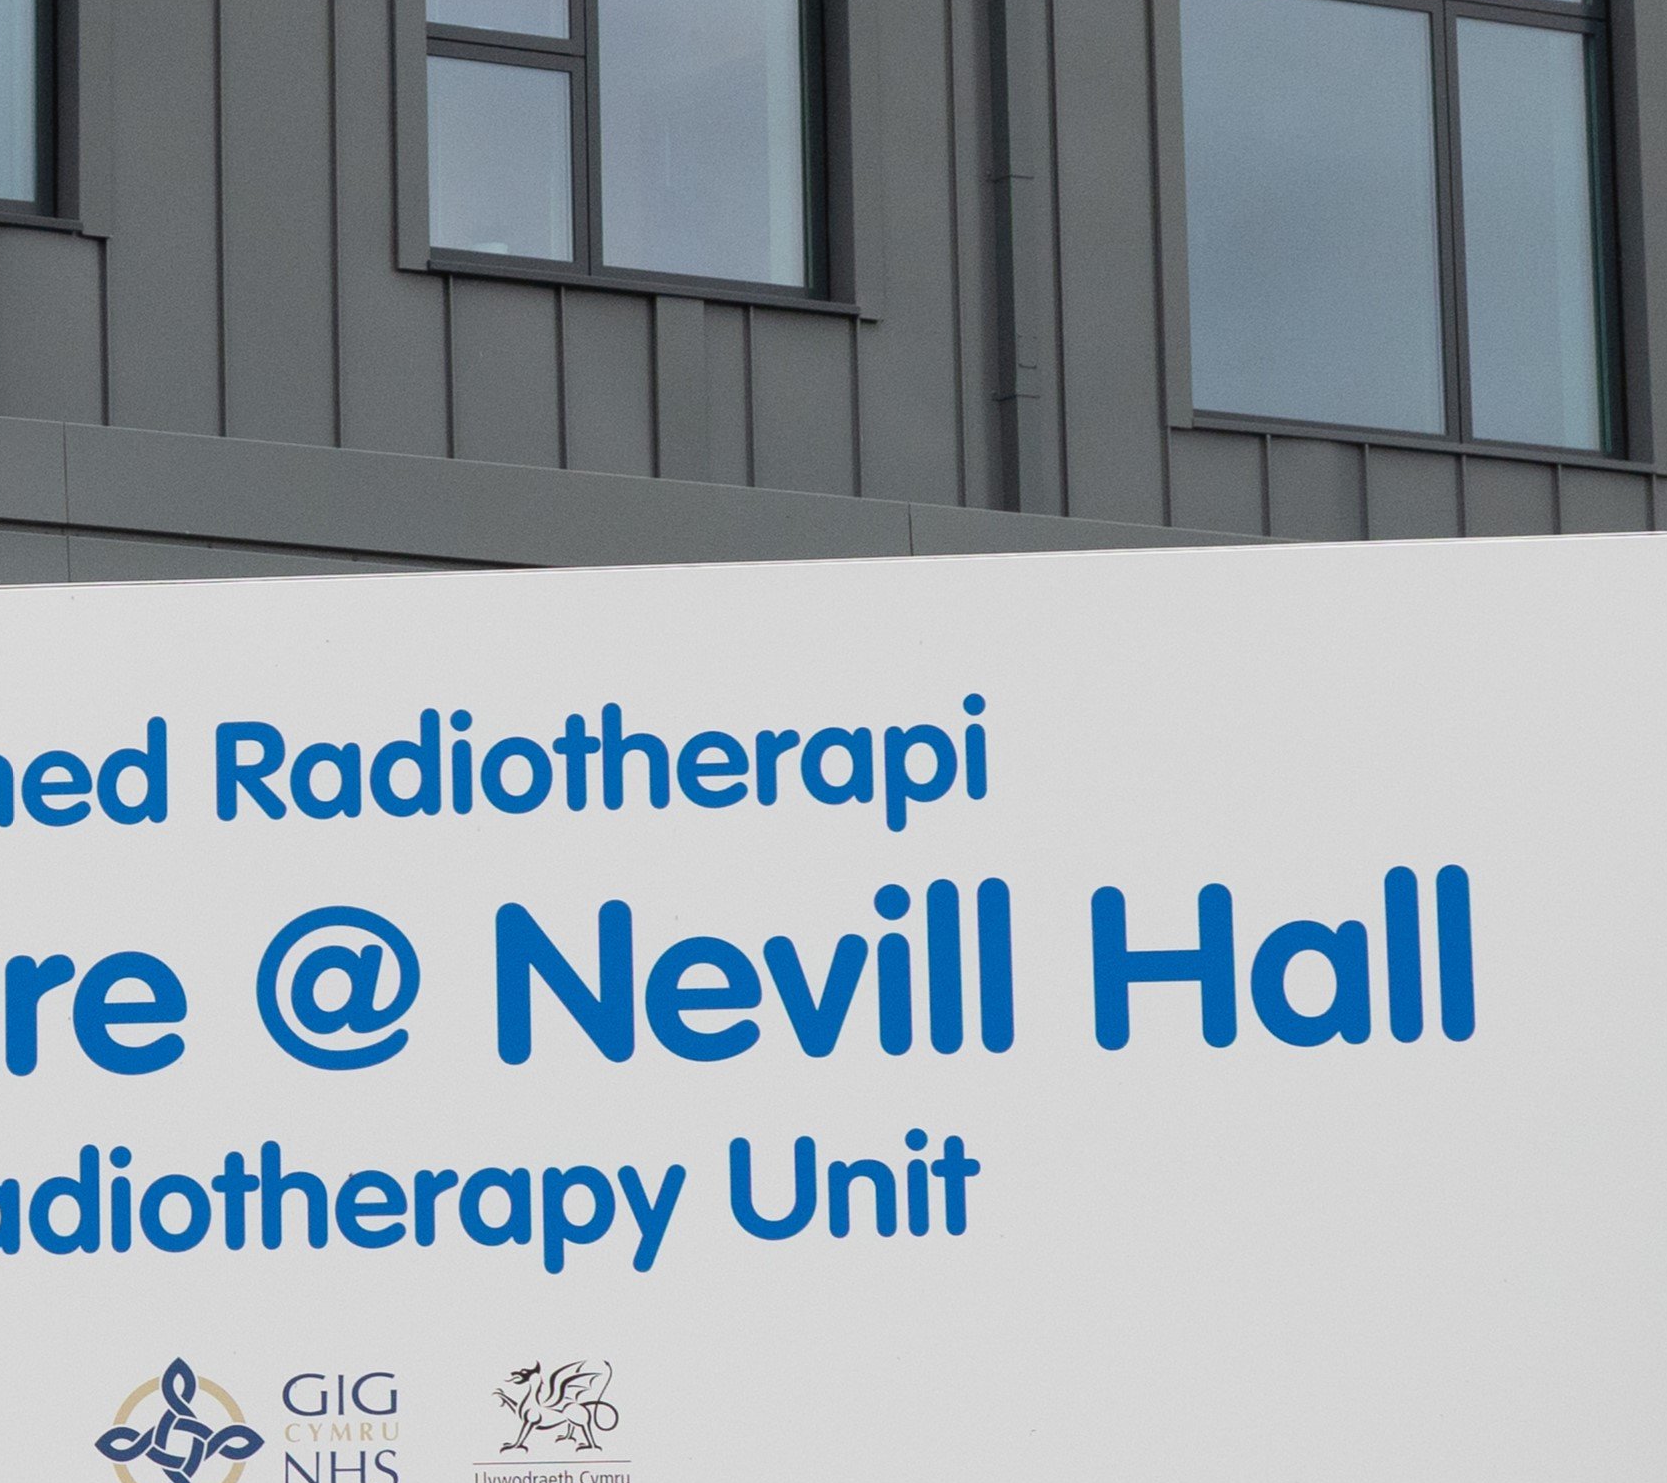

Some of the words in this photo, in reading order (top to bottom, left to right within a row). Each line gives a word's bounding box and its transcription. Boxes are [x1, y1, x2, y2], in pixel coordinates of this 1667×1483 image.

[215, 692, 989, 833] Radiotherapi
[255, 905, 422, 1071] @
[494, 875, 1016, 1066] Nevill
[1089, 863, 1476, 1052] Hall
[727, 1126, 981, 1241] Unit
[281, 1371, 399, 1417] GIG
[284, 1420, 400, 1443] CYMRU
